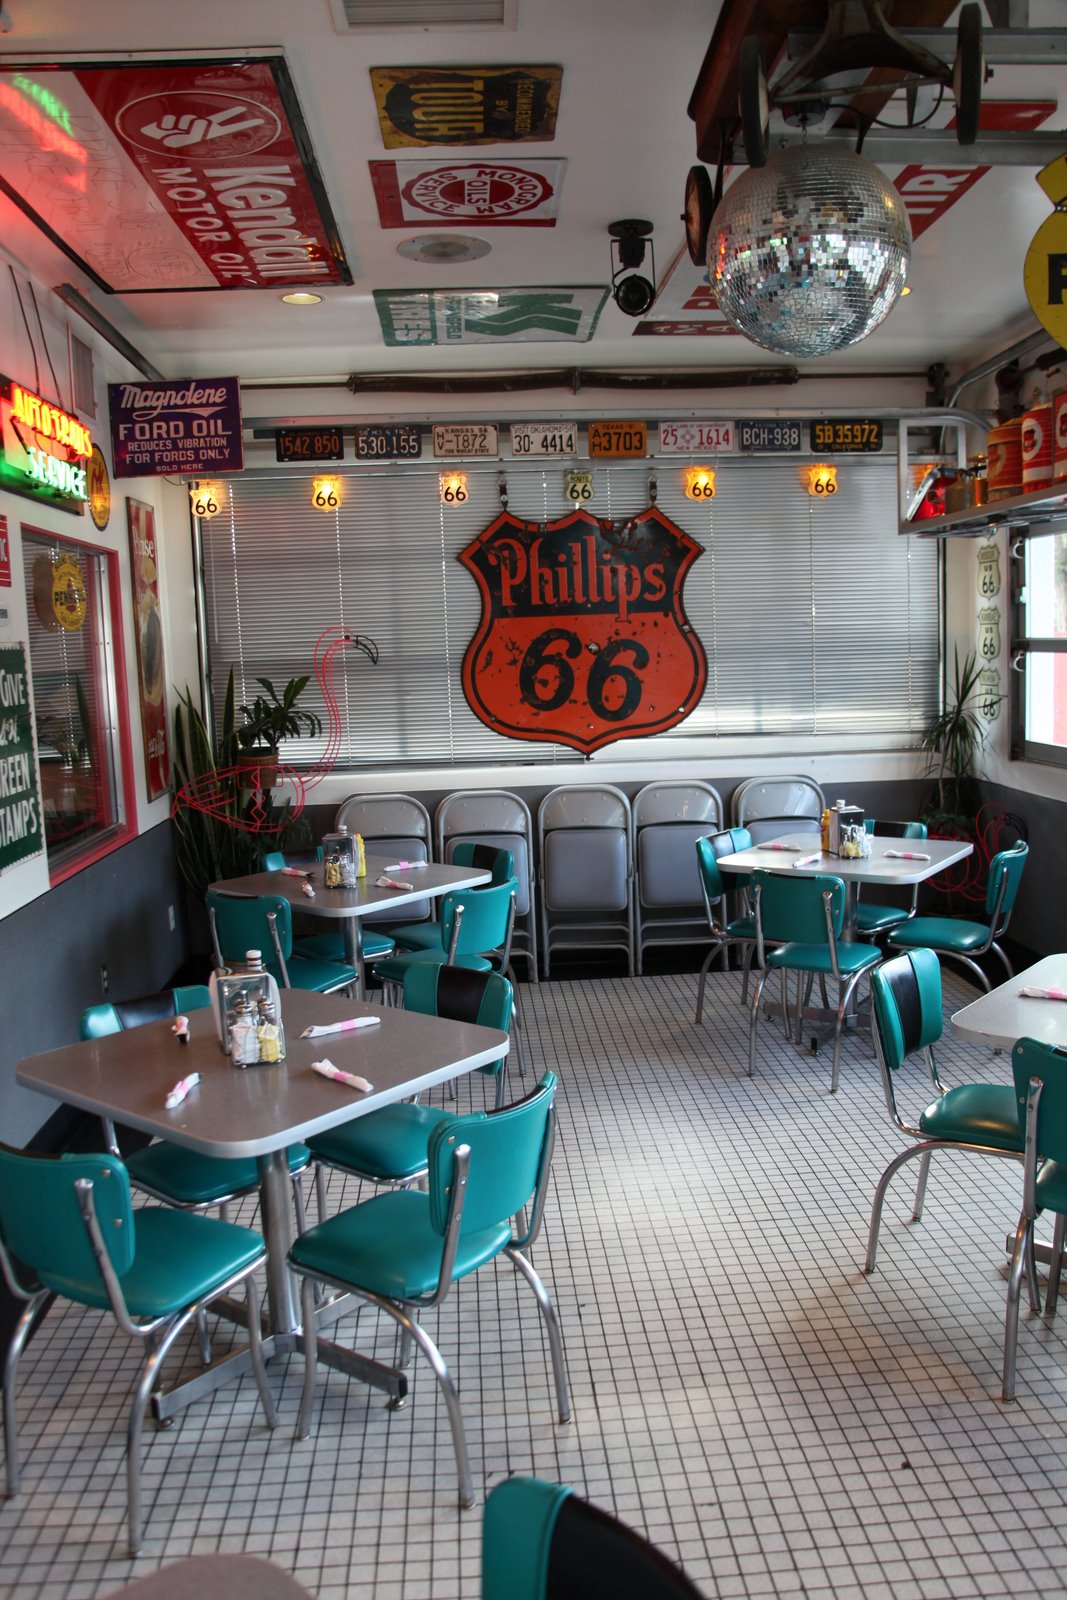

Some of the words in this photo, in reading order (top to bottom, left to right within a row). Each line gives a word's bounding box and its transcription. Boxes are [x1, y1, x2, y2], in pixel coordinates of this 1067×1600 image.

[495, 100, 509, 114] BY
[414, 172, 461, 213] SERVICE
[466, 179, 488, 205] OILS
[475, 169, 539, 215] MONOGRAM
[152, 167, 232, 243] MOTOR
[211, 252, 252, 278] OIL
[203, 165, 330, 277] Kendall
[388, 293, 432, 342] TIRES
[120, 382, 227, 412] Magnolene
[119, 421, 184, 441] FORD
[192, 419, 232, 437] OIL
[662, 428, 678, 445] 25
[698, 428, 729, 445] 1614
[743, 428, 798, 445] BCH-938
[128, 440, 172, 451] REDUCES
[177, 437, 227, 448] VIBRATION
[314, 435, 339, 454] 850
[541, 434, 573, 452] 4414
[603, 431, 642, 451] 3703
[126, 453, 150, 464] FOR
[155, 450, 195, 463] FORDS
[199, 448, 230, 460] ONLY
[26, 447, 87, 500] SERVICE
[443, 485, 466, 502] 66
[569, 484, 592, 500] 66
[692, 482, 713, 497] 66
[814, 478, 836, 494] 66
[195, 497, 217, 515] 66
[315, 491, 338, 507] 66
[487, 535, 666, 623] Phillips
[982, 575, 995, 594] 66
[983, 637, 995, 655] 66
[519, 628, 650, 721] 66
[0, 669, 26, 707] GIVE
[0, 753, 31, 798] REEN
[0, 797, 38, 848] TAMPS
